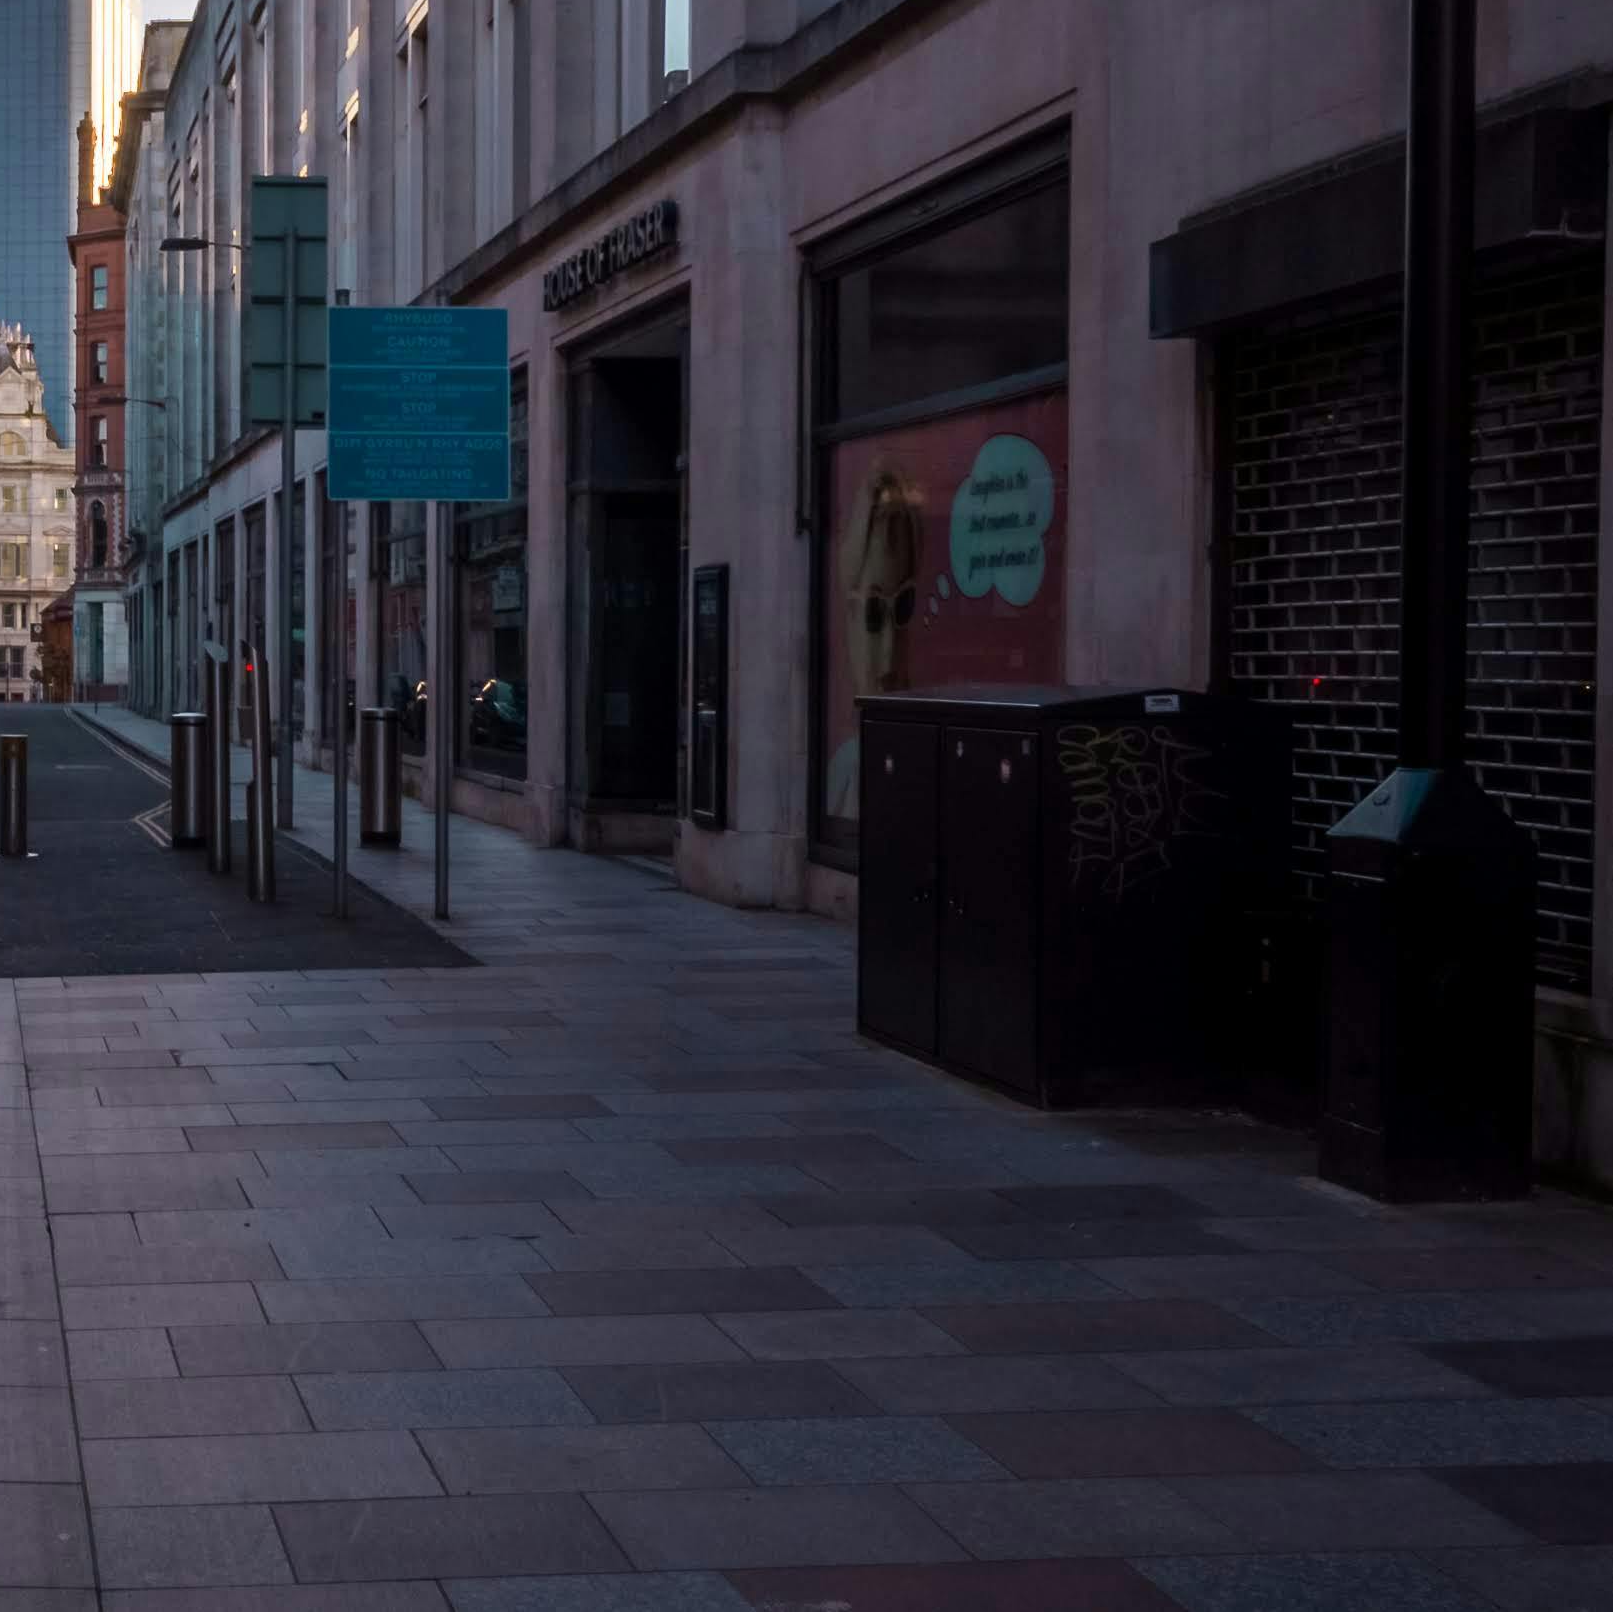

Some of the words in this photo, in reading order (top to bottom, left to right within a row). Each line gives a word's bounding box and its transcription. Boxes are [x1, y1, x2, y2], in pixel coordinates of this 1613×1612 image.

[543, 253, 584, 312] HOUSE
[609, 200, 676, 273] FRASER
[401, 372, 437, 383] STOP
[401, 403, 437, 414] STOP
